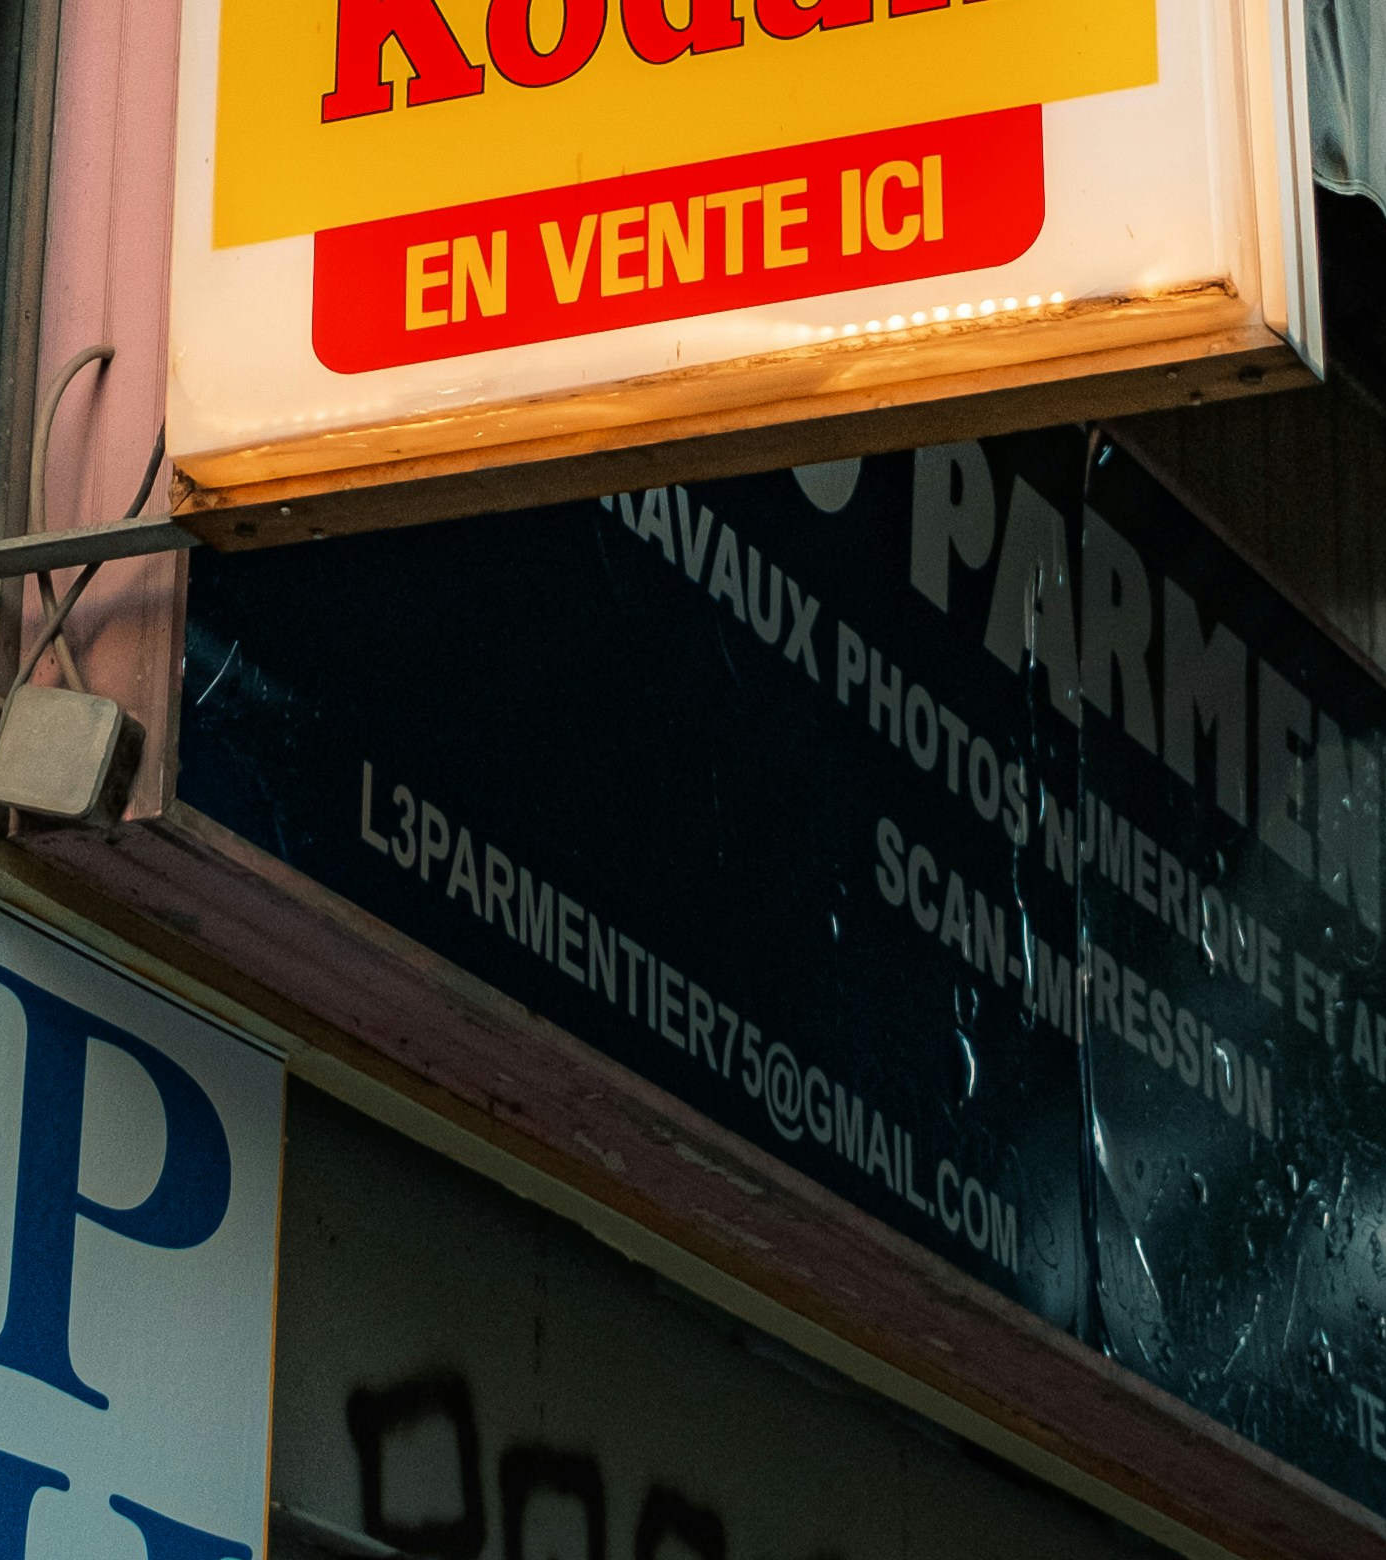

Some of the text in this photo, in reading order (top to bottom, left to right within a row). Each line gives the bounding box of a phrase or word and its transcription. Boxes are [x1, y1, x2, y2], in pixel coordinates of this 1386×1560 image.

[404, 155, 944, 332] EN VENTE ICI
[360, 760, 1019, 1273] L3PARMENTIER75@GMAIL.COM
[600, 483, 821, 683] AVAUX
[836, 619, 1031, 847] PHOTOS
[1294, 950, 1341, 1048] ET
